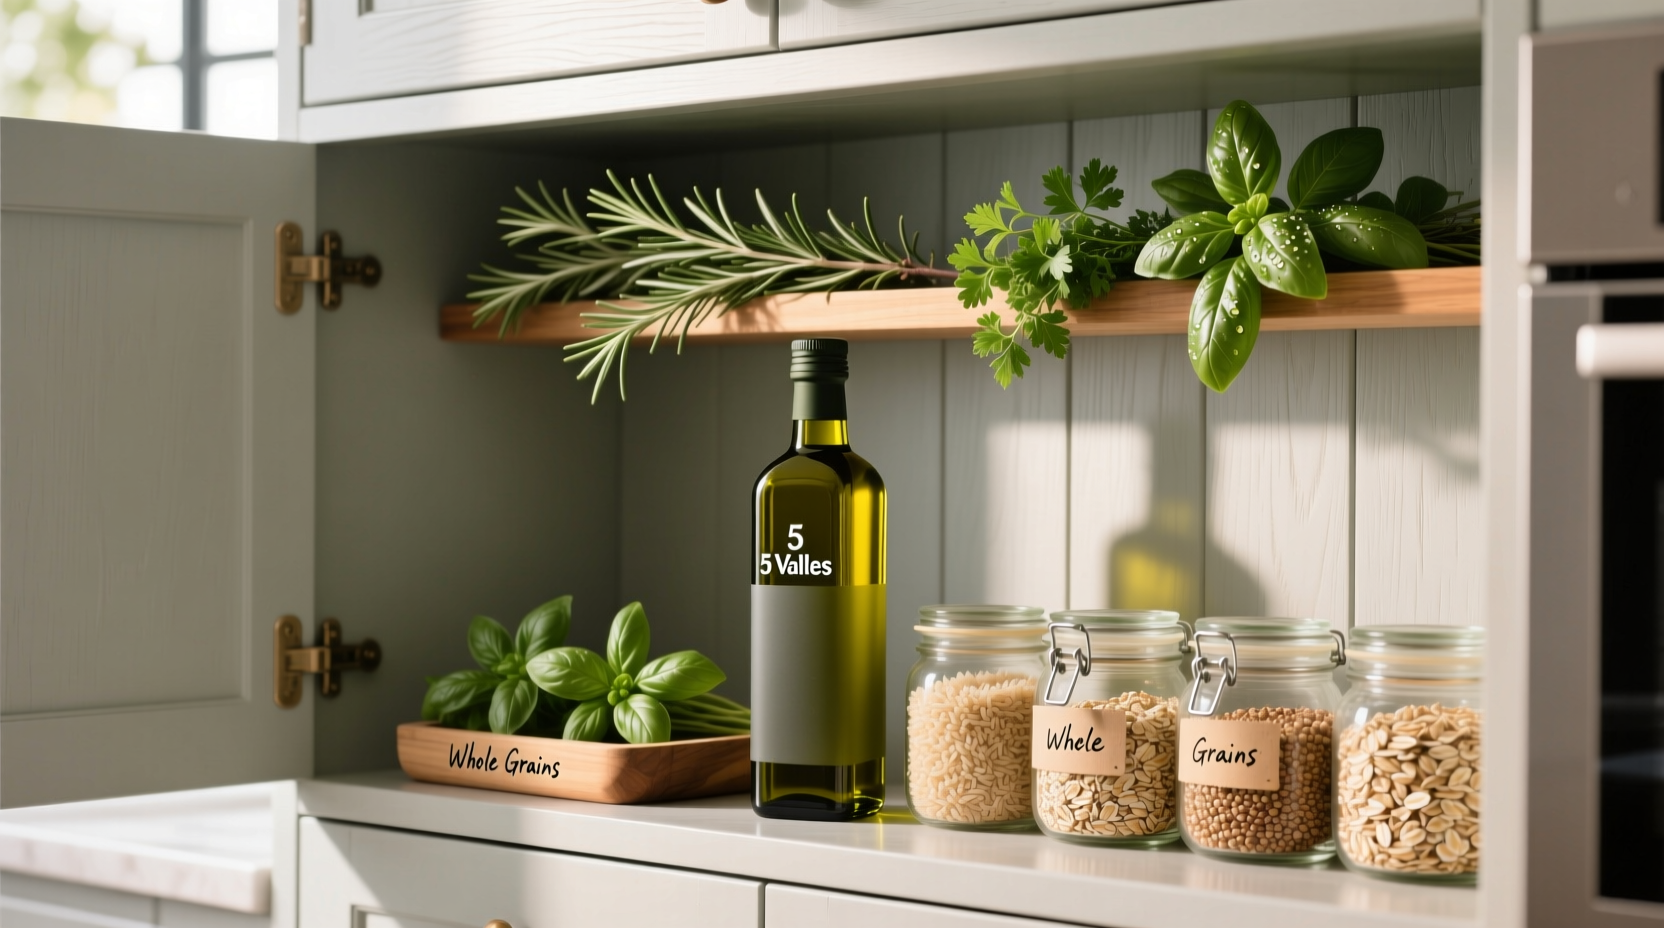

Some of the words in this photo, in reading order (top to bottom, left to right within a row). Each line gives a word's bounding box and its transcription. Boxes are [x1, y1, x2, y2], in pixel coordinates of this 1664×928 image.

[787, 523, 804, 551] 5
[760, 553, 772, 575] 5
[774, 553, 832, 576] Valles
[449, 741, 498, 772] Whole
[505, 747, 560, 779] Grains
[1192, 736, 1258, 767] Grains
